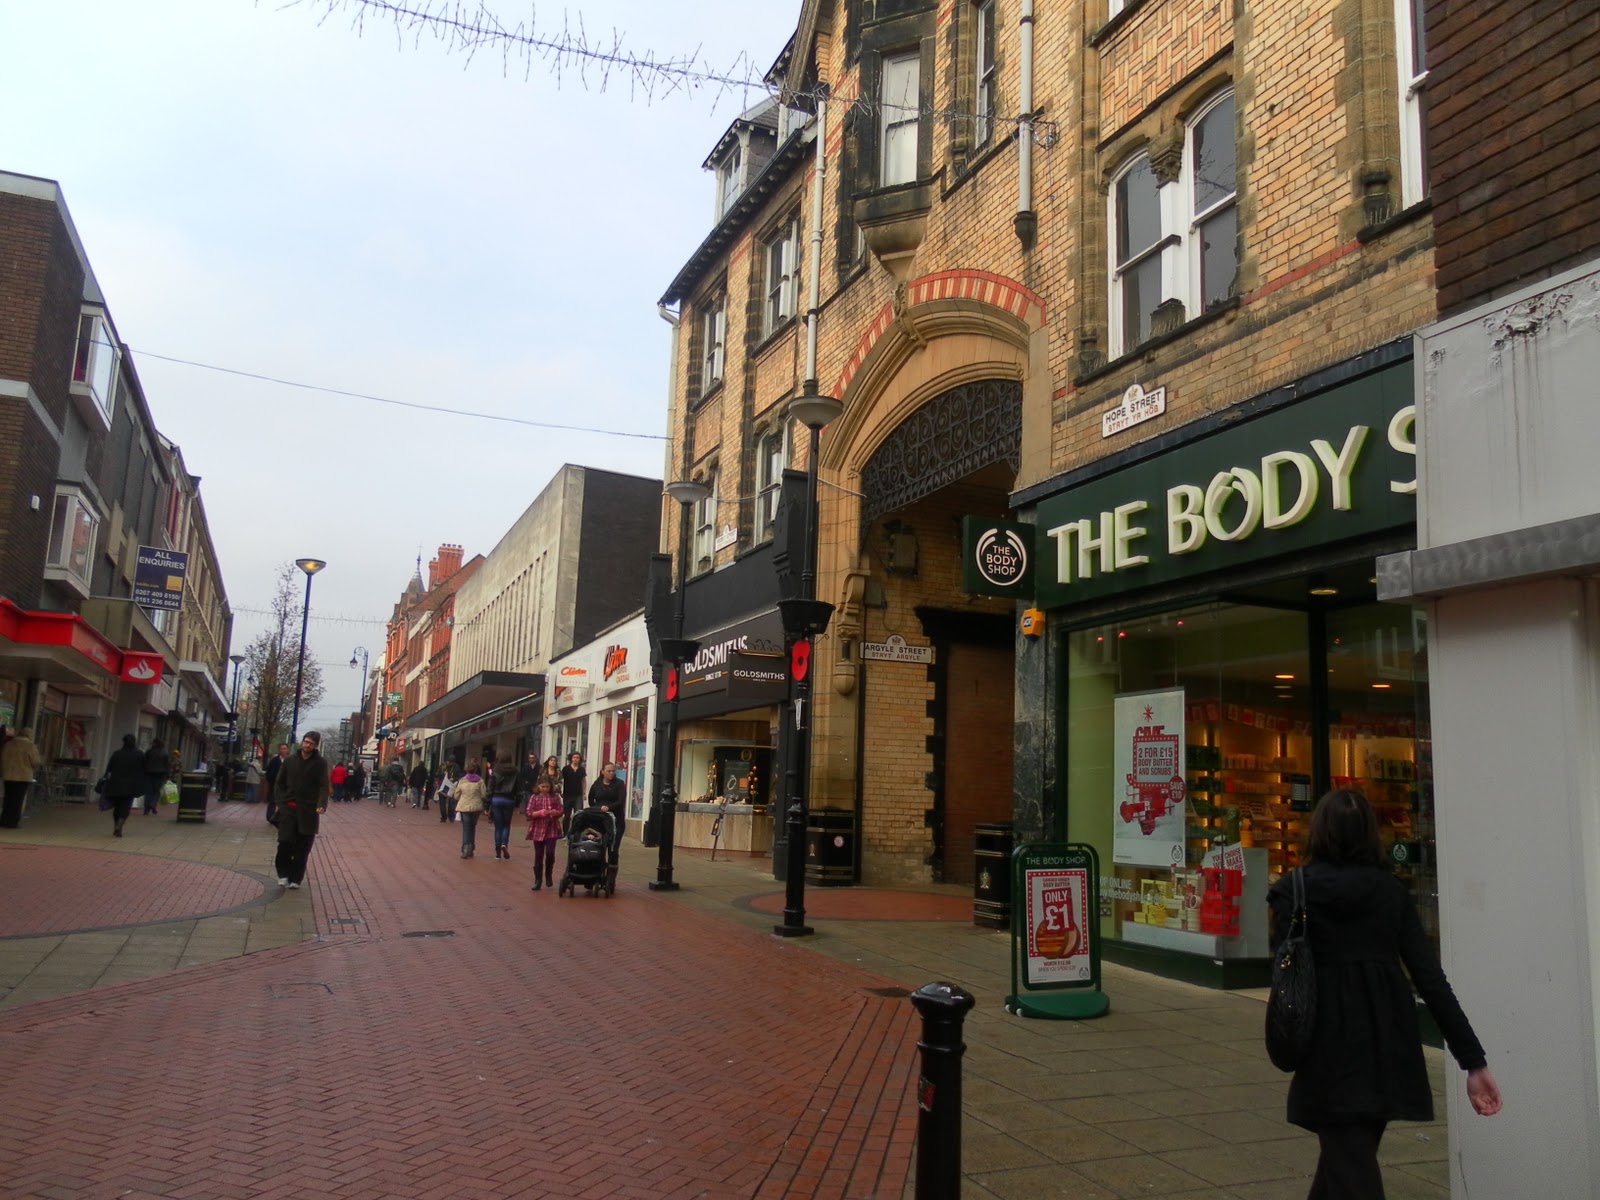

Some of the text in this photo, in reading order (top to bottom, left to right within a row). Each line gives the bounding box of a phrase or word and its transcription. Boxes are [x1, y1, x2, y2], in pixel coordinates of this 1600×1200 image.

[1105, 391, 1161, 424] HOPE STREET
[1108, 417, 1129, 433] STRYT
[1132, 412, 1142, 422] YR
[1047, 500, 1149, 584] THE
[1167, 425, 1369, 555] BODY
[992, 545, 1011, 556] THE
[139, 557, 185, 569] ENQUIRIES
[986, 553, 1017, 567] BODY
[988, 564, 1016, 576] SHOP
[135, 588, 150, 596] 0207
[865, 644, 927, 655] ARGYLE STREET
[896, 653, 920, 661] ARGYLE
[733, 669, 785, 680] GOLDSMITHS
[1138, 747, 1173, 758] 2 FOR £15
[1138, 758, 1173, 767] BODY BUTTER
[1138, 767, 1172, 776] AND SCRUBS
[1170, 782, 1183, 790] SAVE
[1172, 791, 1182, 799] £10
[1026, 856, 1086, 865] THE BODY SHOP
[1110, 877, 1132, 889] ONLINE
[1044, 890, 1068, 904] ONLY
[1045, 903, 1070, 931] £1
